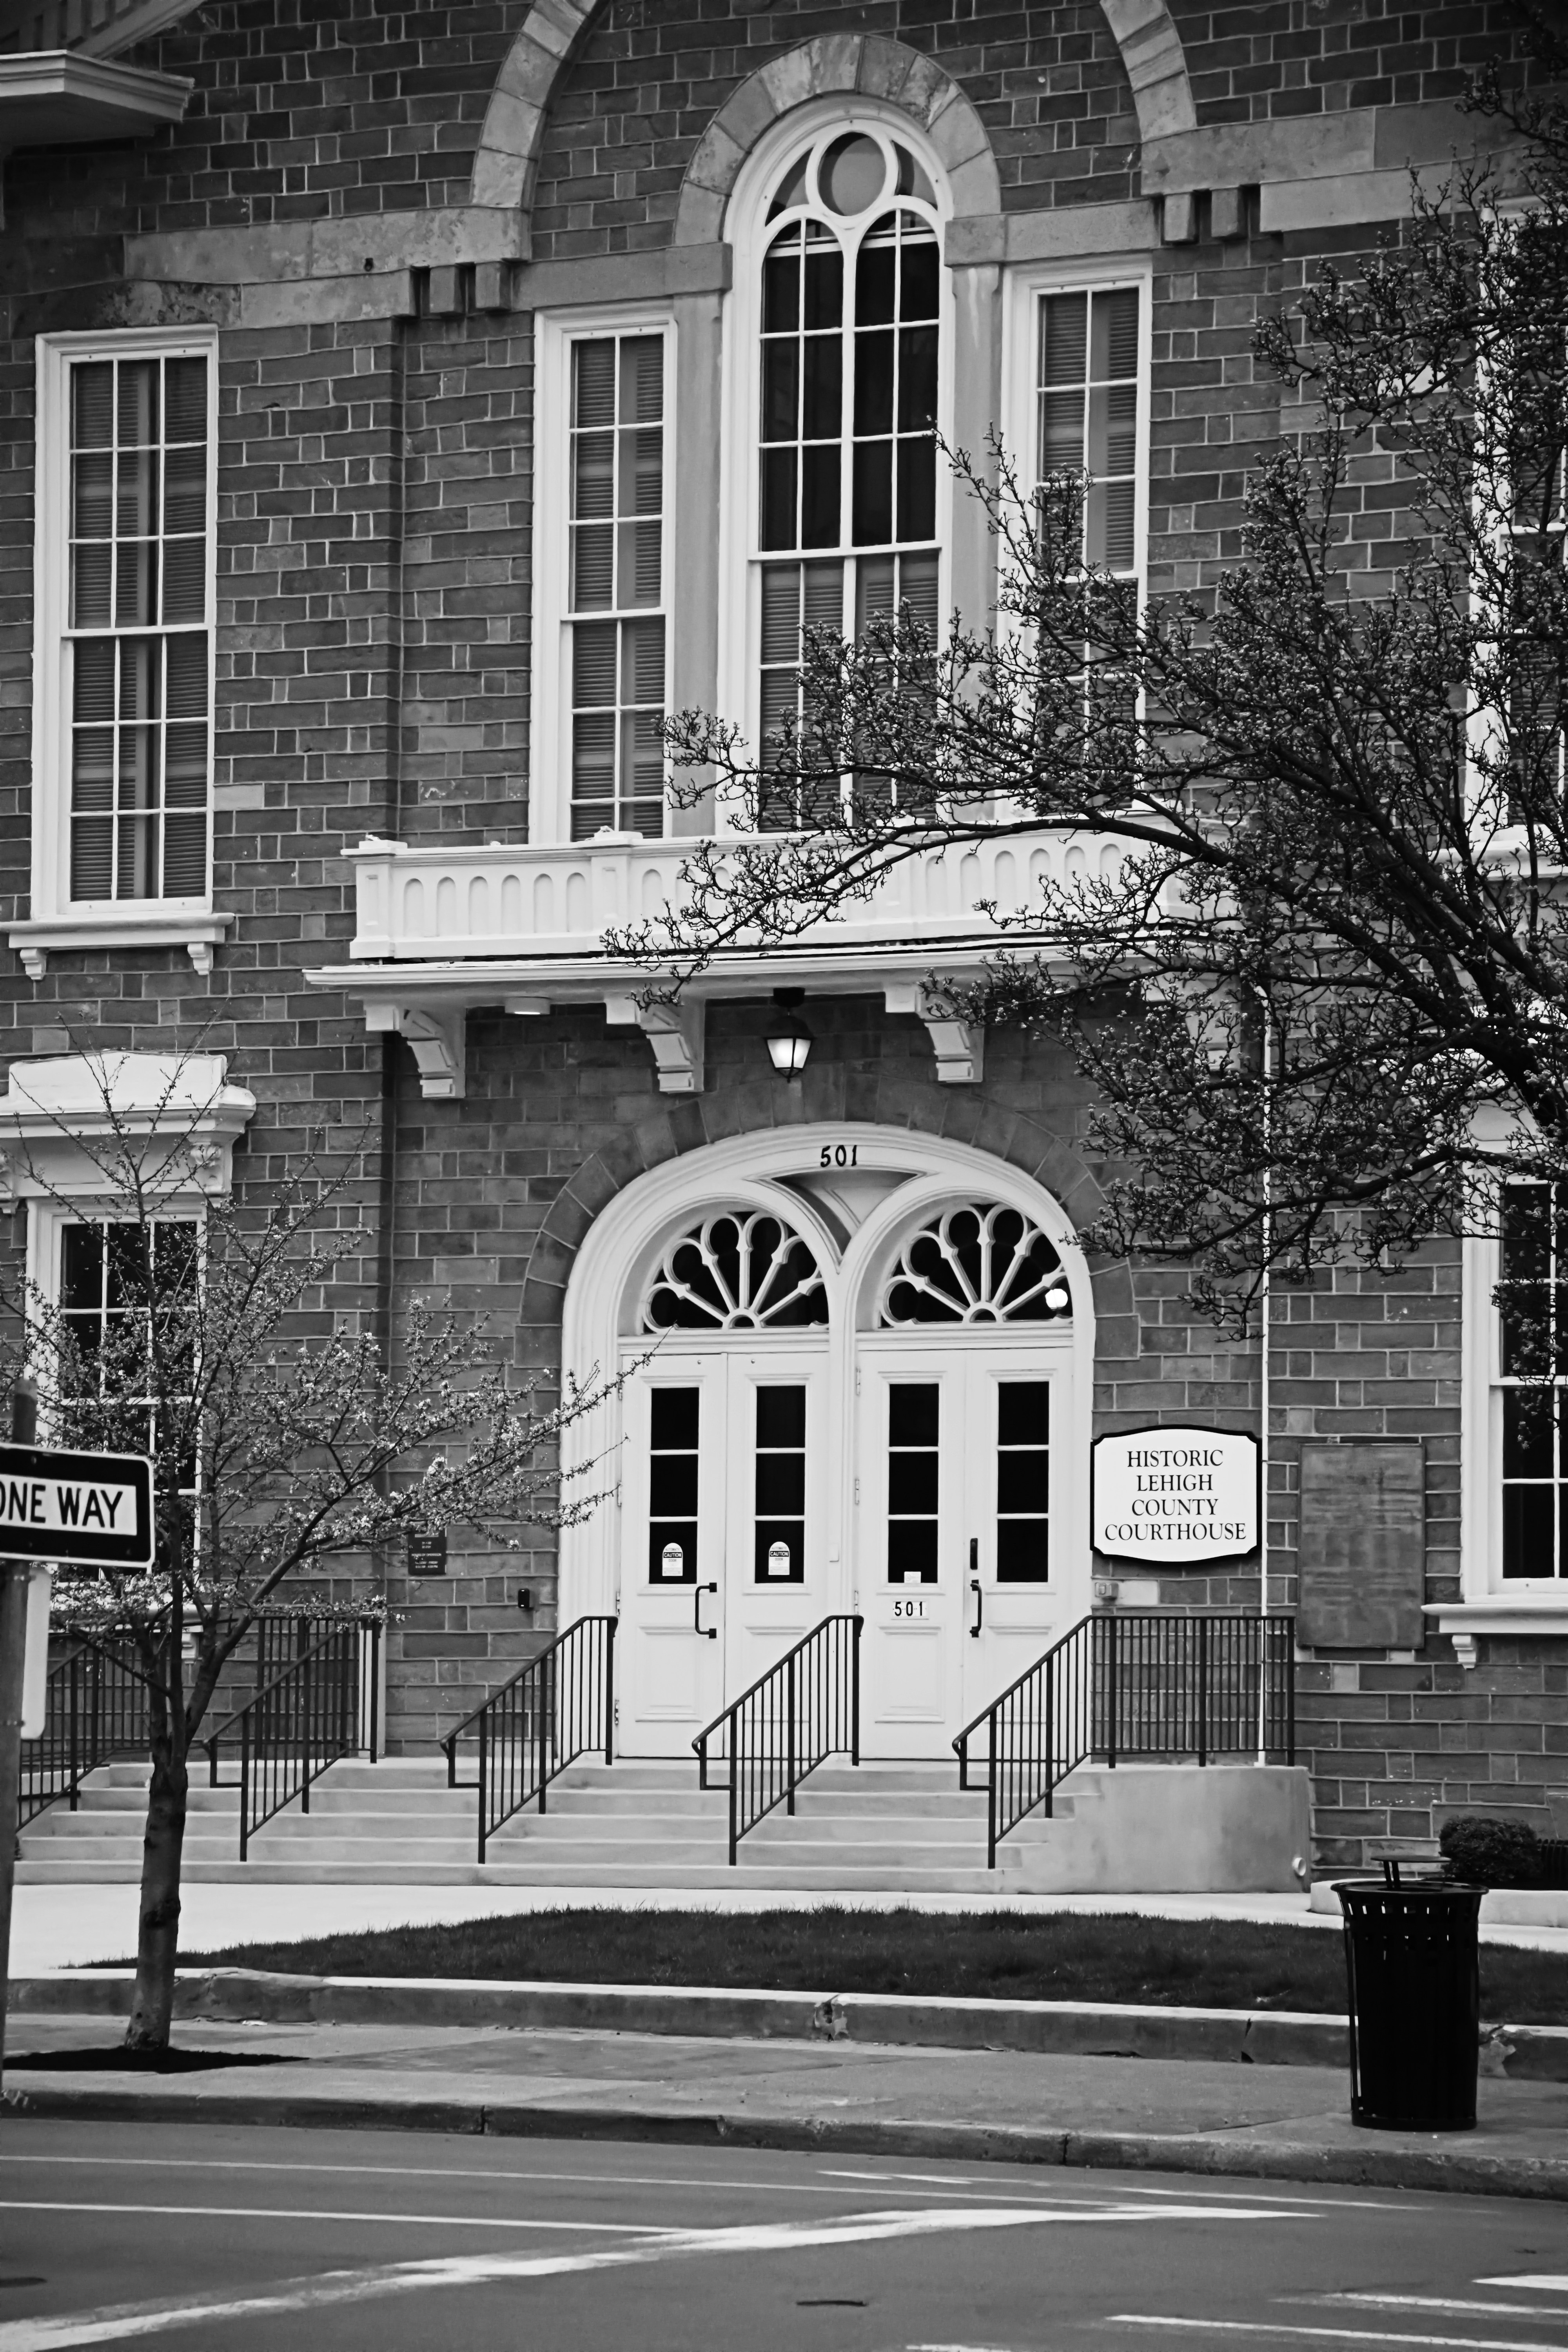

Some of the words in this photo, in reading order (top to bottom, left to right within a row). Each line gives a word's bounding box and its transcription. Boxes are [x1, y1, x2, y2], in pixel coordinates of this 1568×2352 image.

[820, 1145, 857, 1168] 501
[1127, 1450, 1223, 1467] HISTORIC
[1136, 1474, 1213, 1492] LEHIGH
[57, 1486, 123, 1528] WAY
[1132, 1499, 1218, 1516] COUNTY
[1105, 1523, 1246, 1541] COURTHOUSE
[895, 1601, 922, 1616] 501
